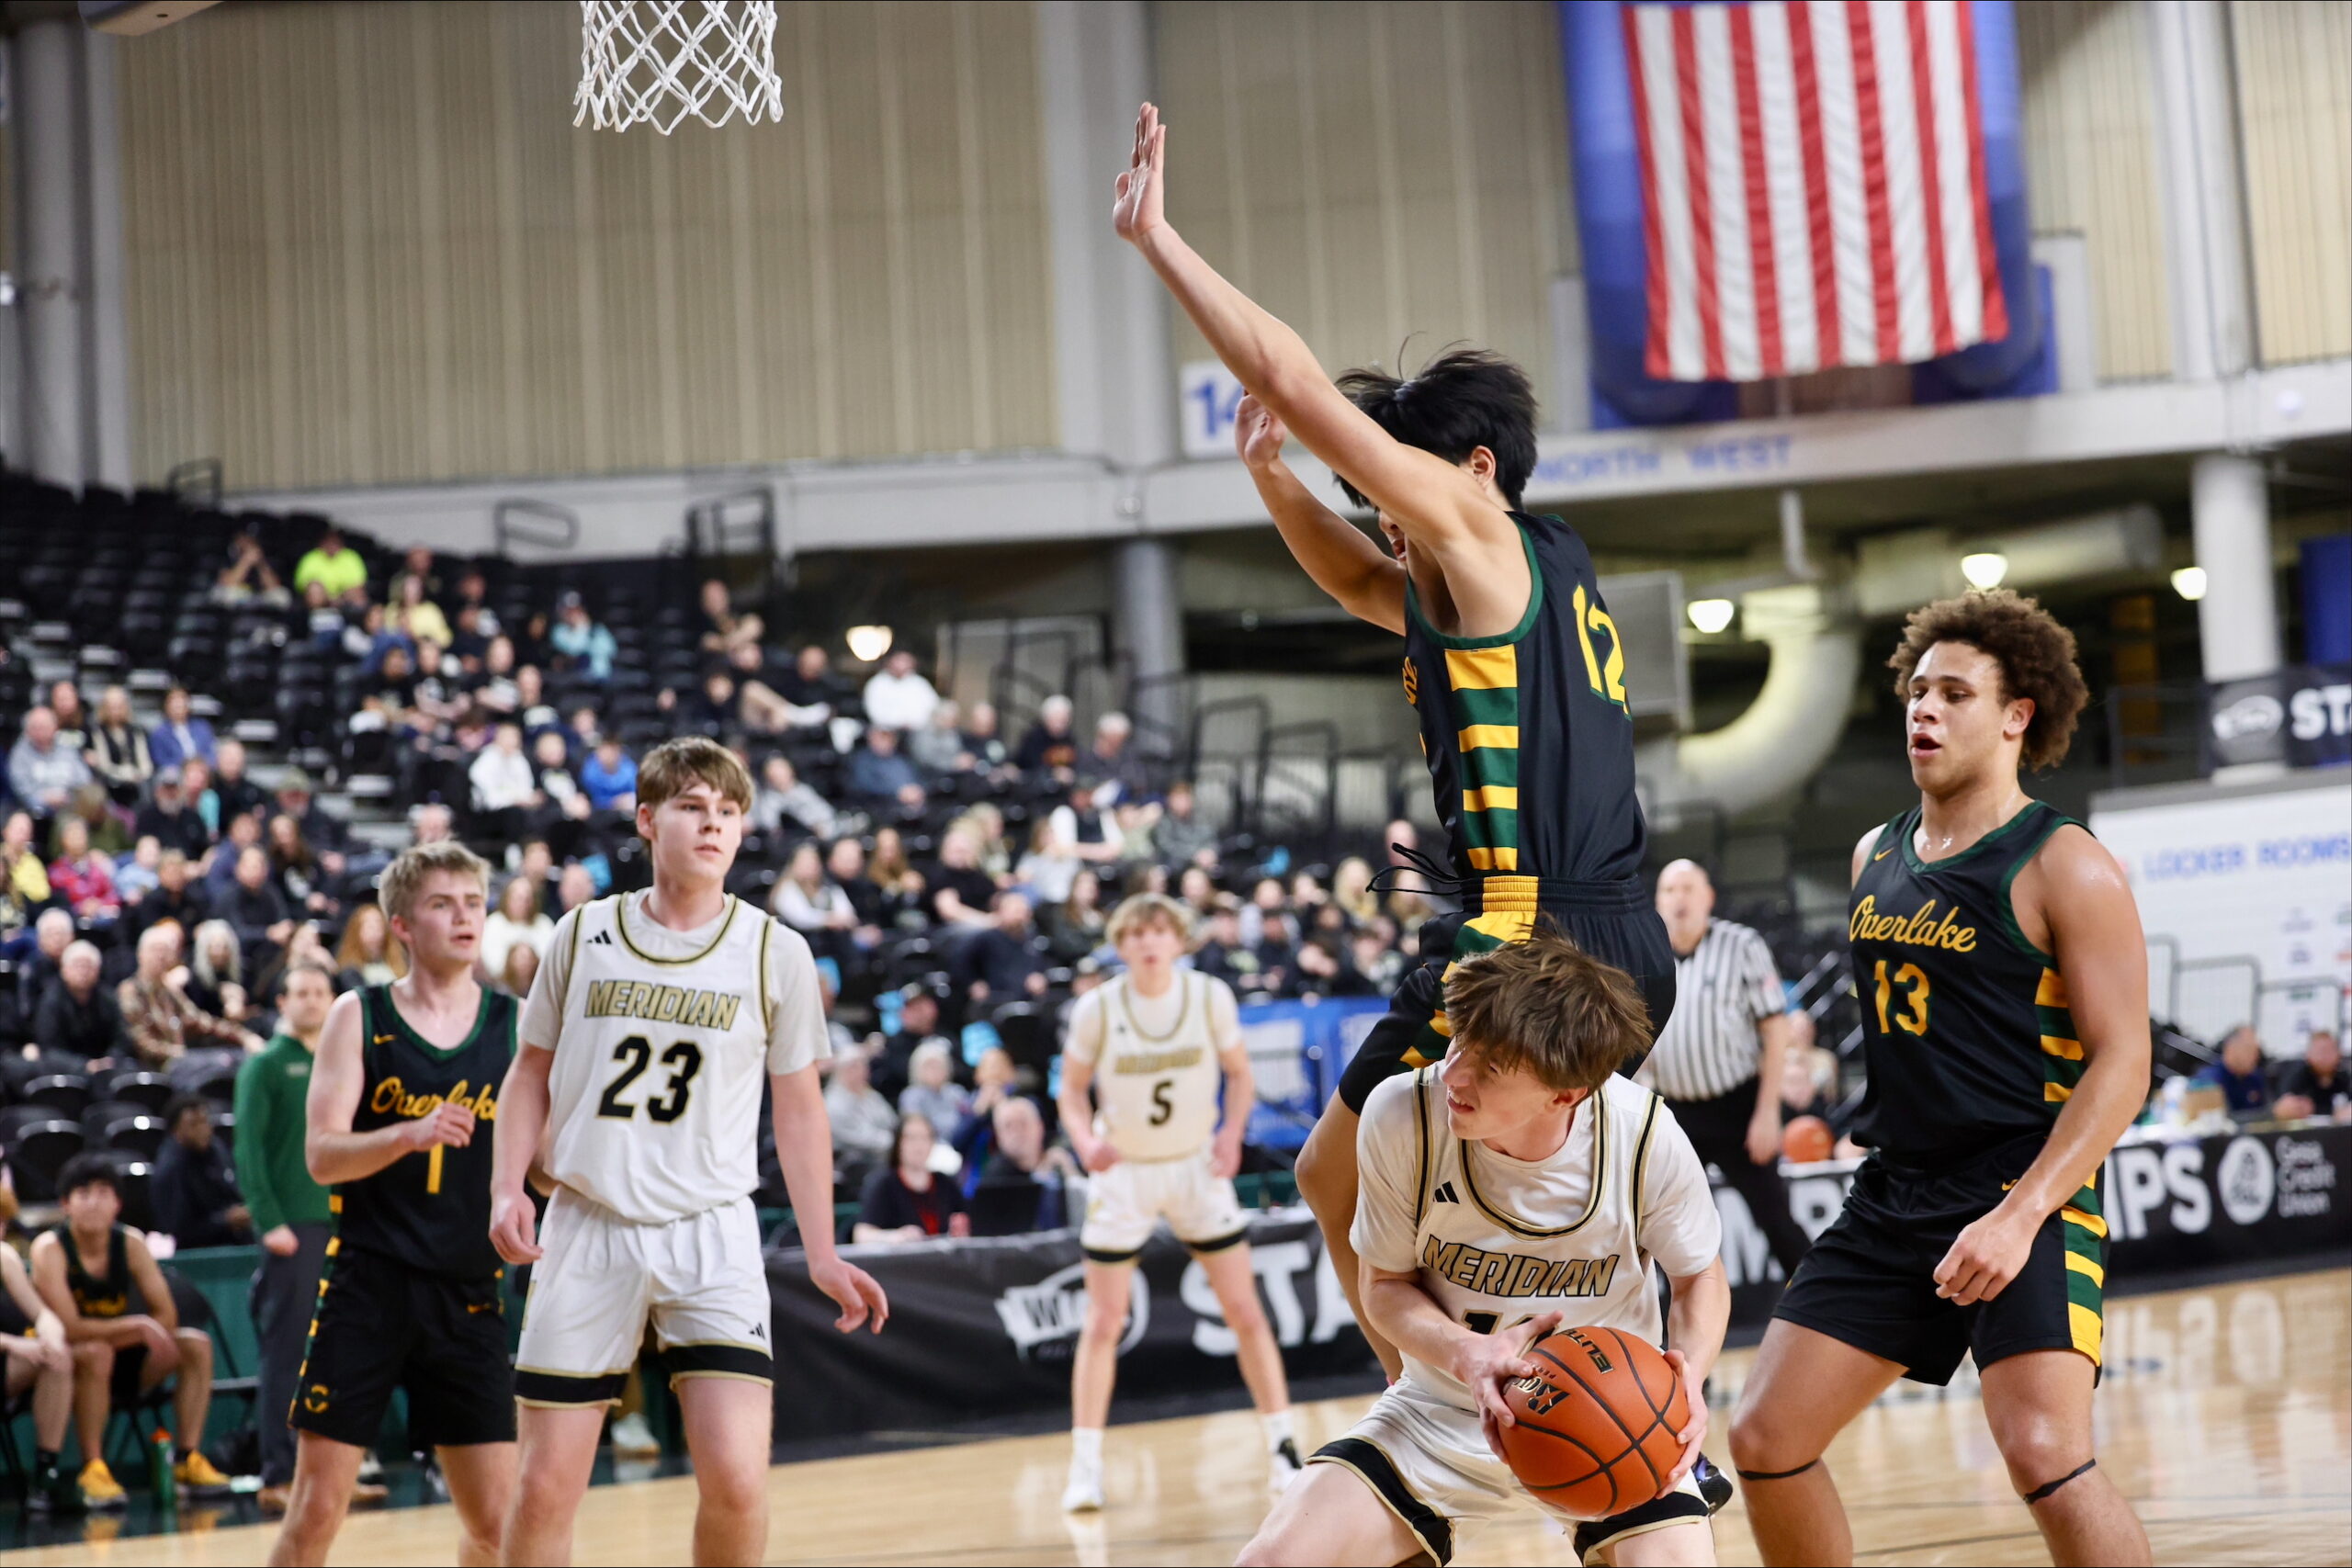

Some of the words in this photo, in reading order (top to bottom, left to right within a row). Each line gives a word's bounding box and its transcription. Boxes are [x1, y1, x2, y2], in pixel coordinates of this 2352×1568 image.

[1572, 584, 1631, 720] 12
[2290, 683, 2351, 740] ST
[1849, 894, 1977, 953] Overlake
[583, 979, 741, 1032] MERIDIAN
[1872, 959, 1931, 1038] 13
[595, 1034, 705, 1126] 23
[1148, 1078, 1173, 1126] 5
[1422, 1234, 1621, 1297] MERIDIAN
